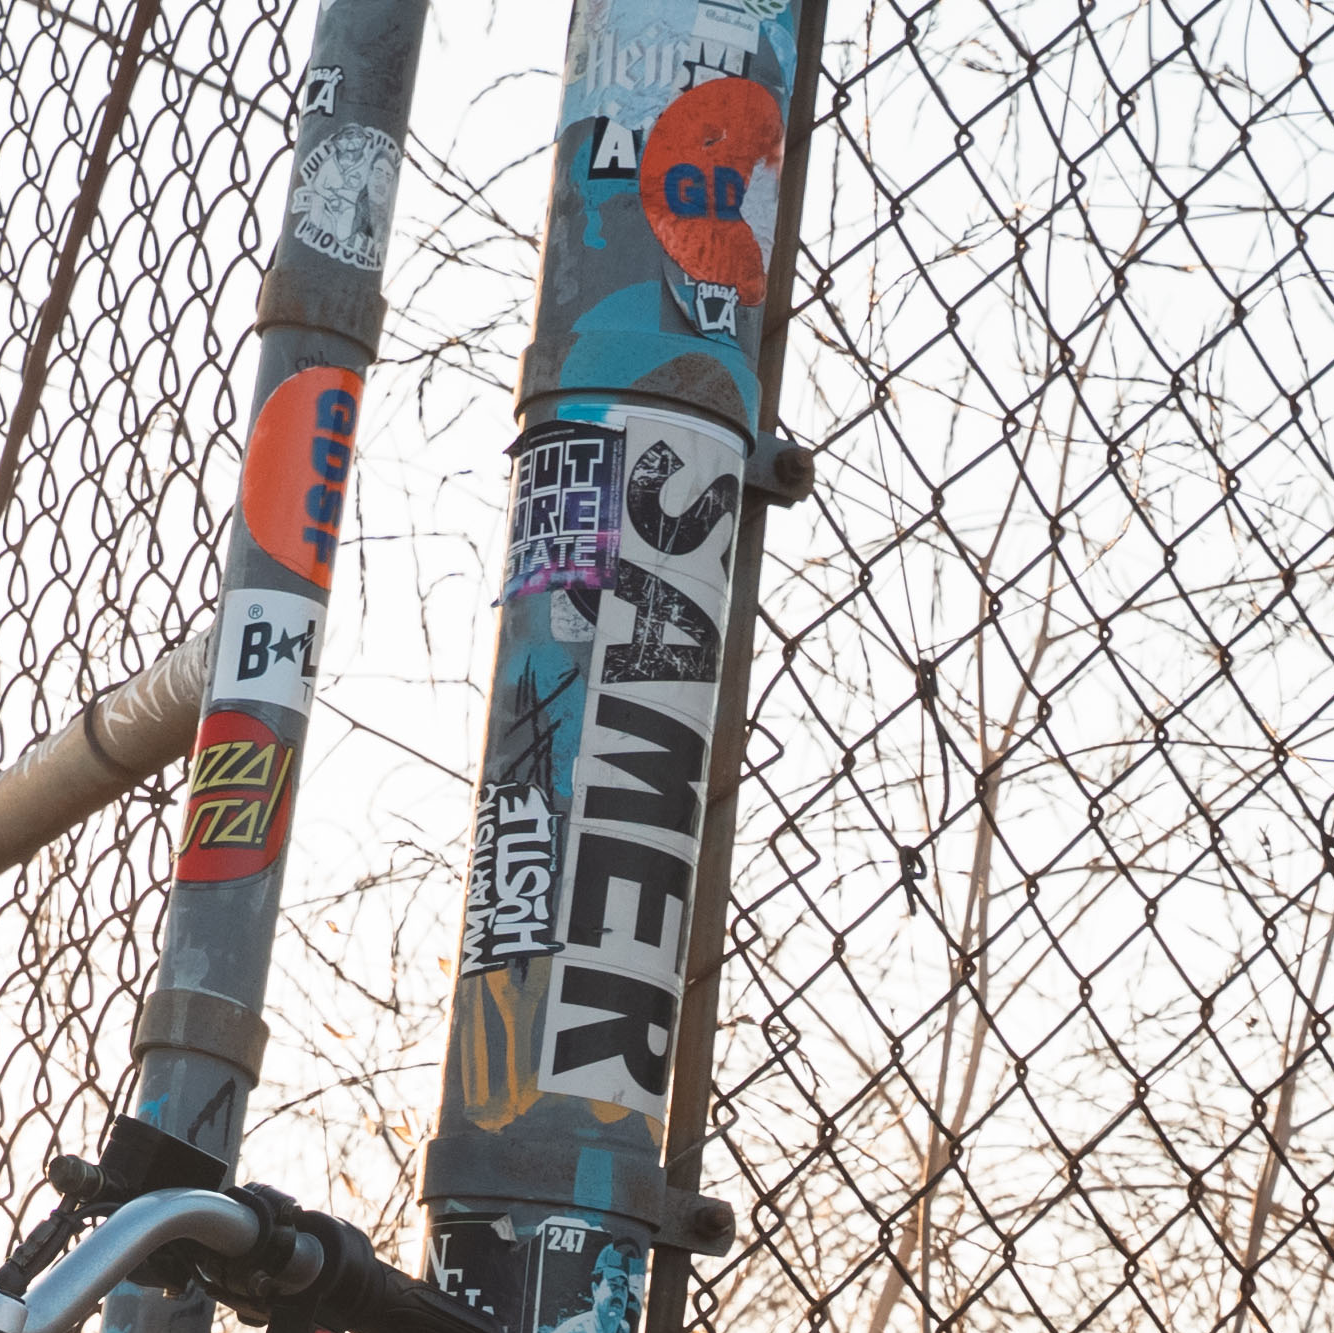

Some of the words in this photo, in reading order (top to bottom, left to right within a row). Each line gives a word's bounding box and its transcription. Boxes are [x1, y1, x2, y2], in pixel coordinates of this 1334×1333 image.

[506, 536, 597, 581] STATE
[491, 785, 553, 957] HUSTLE
[547, 1227, 586, 1254] 247
